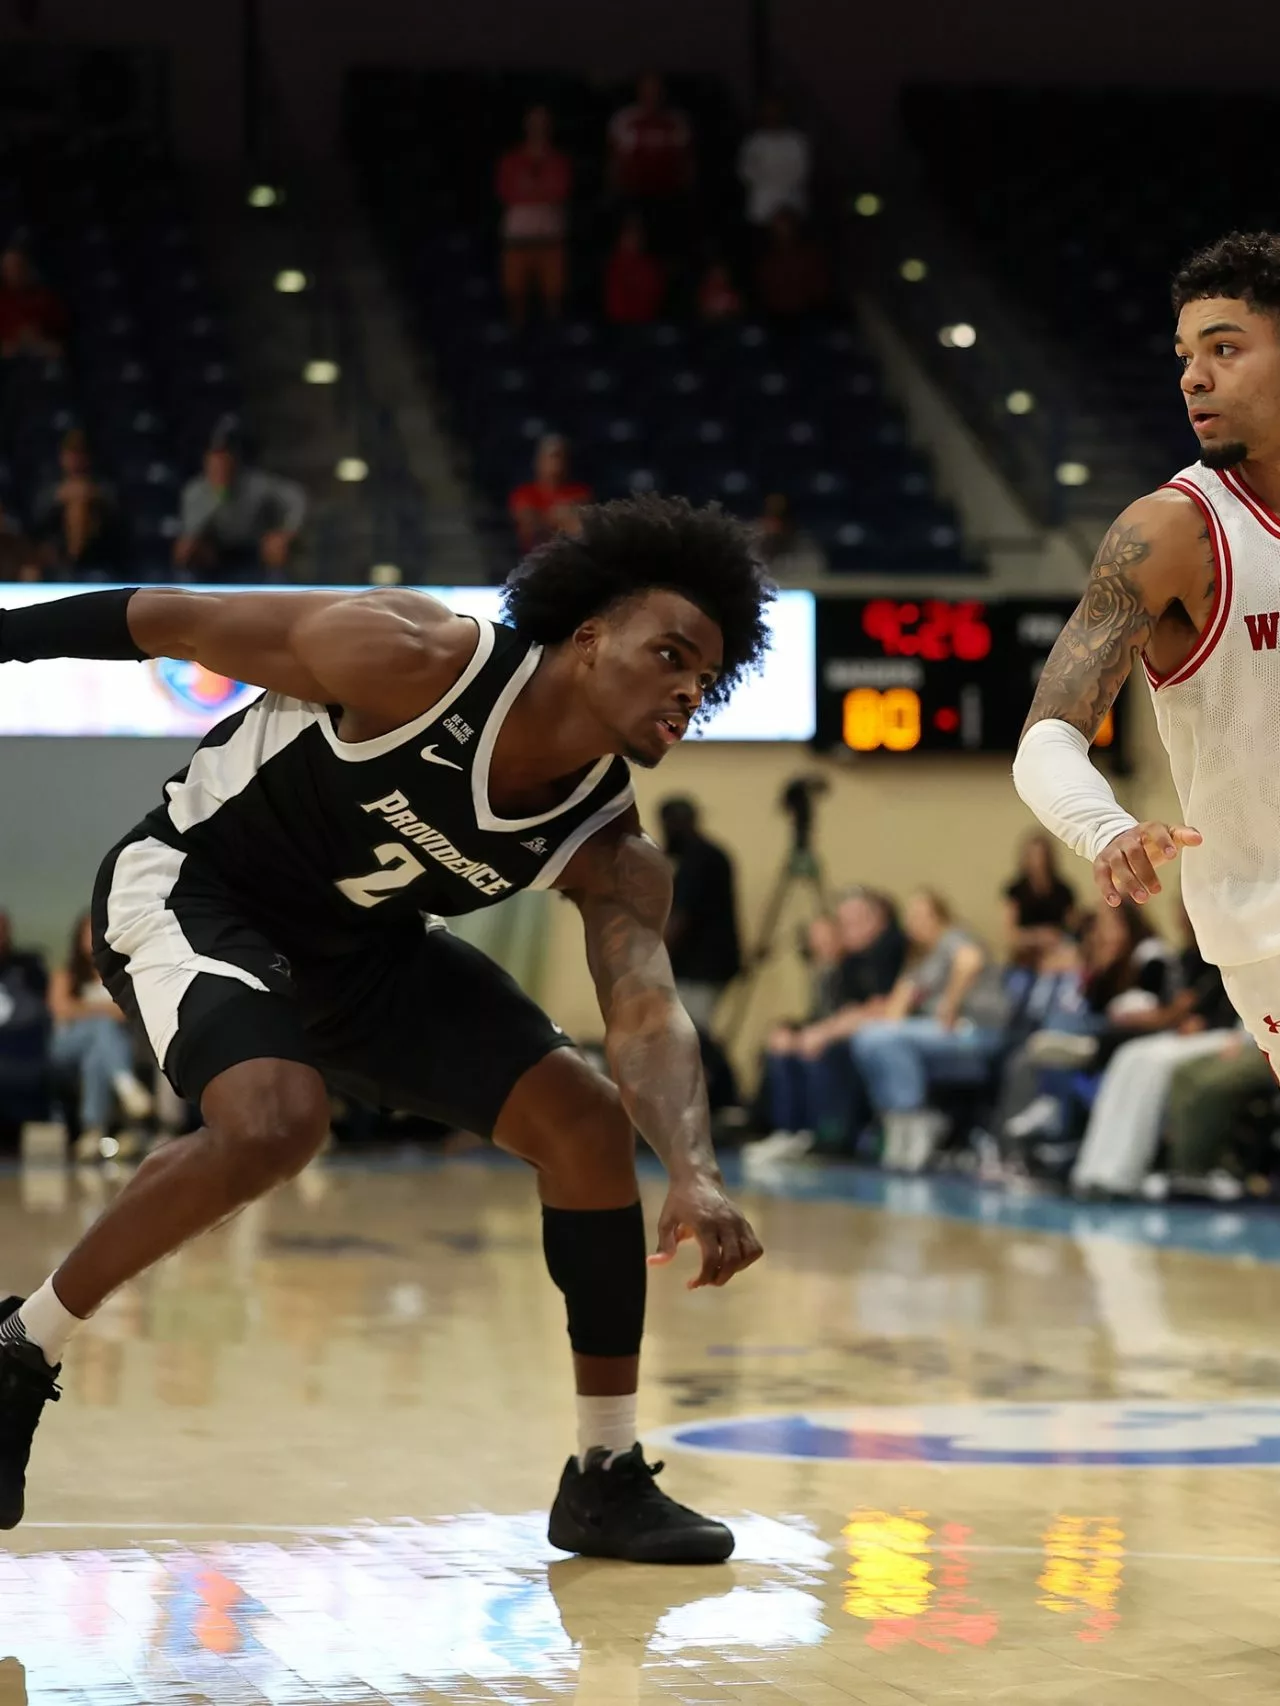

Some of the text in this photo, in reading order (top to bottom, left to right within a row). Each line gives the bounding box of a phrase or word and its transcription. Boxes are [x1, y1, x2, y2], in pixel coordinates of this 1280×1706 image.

[442, 718, 469, 745] CHANGE
[451, 714, 475, 738] BE THE
[360, 789, 514, 896] PROVIDENCE
[334, 842, 428, 908] 2
